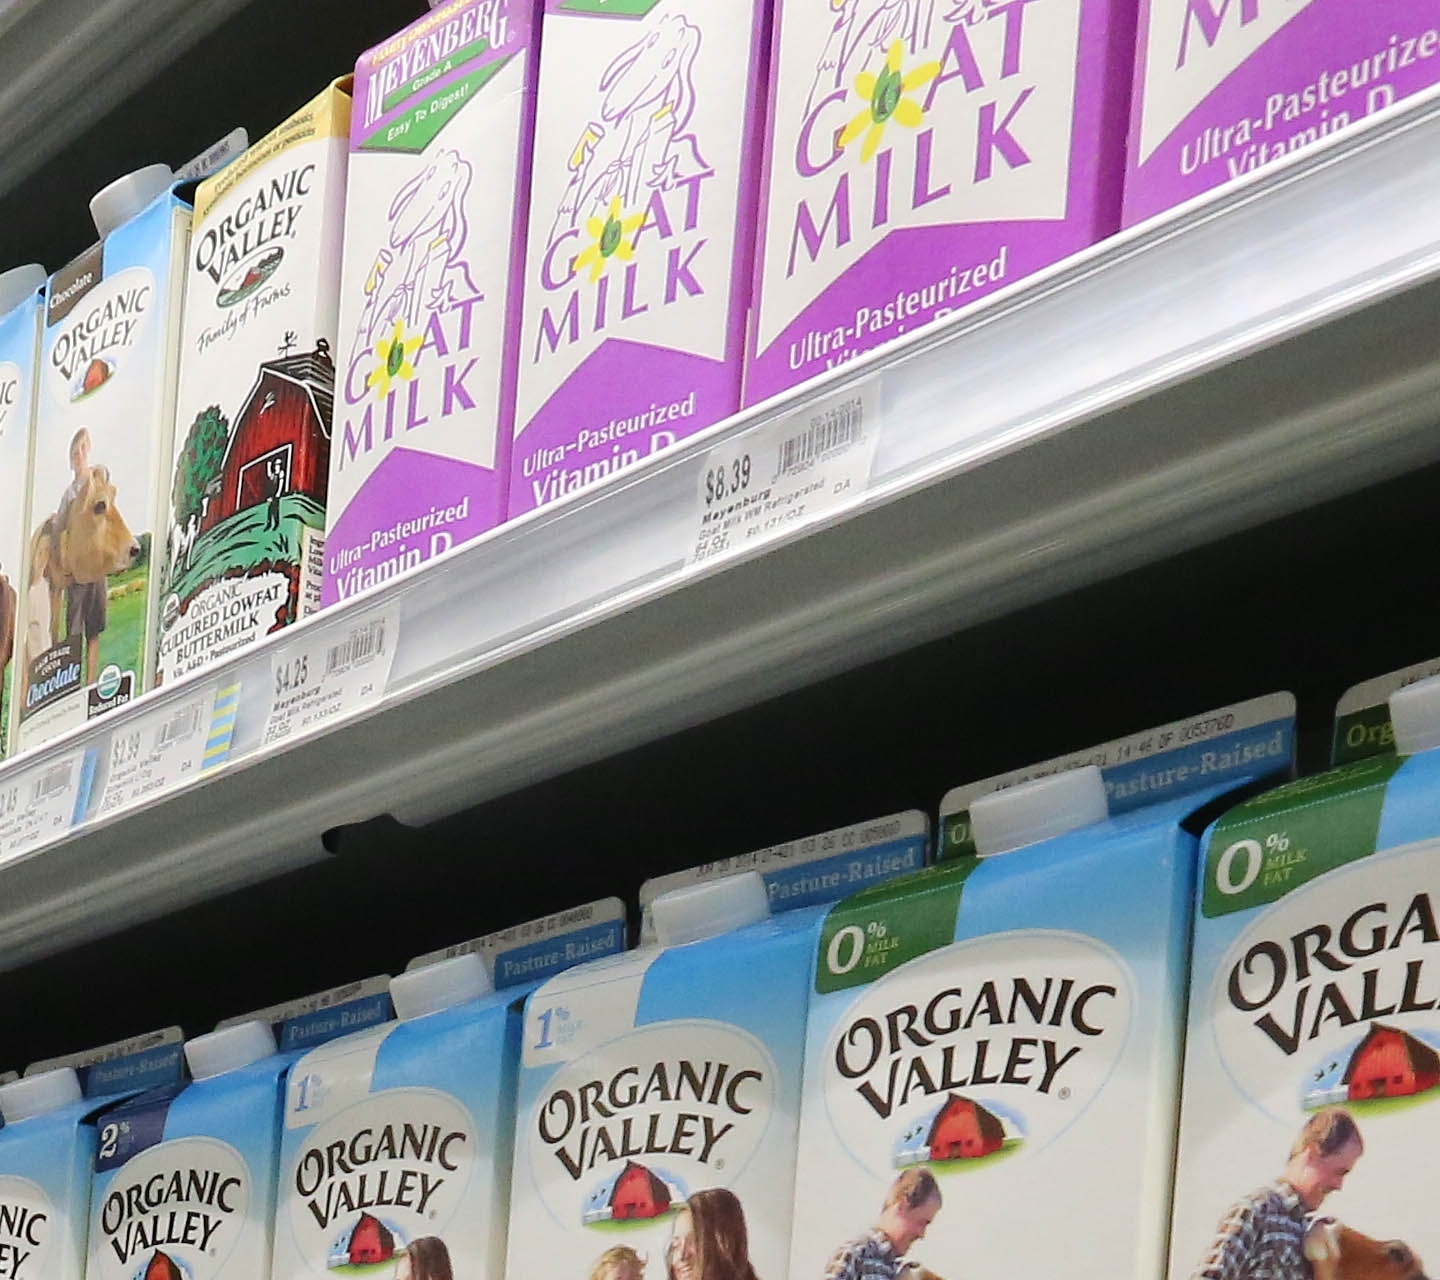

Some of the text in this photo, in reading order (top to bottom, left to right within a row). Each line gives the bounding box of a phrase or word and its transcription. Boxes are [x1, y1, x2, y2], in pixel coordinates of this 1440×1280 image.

[363, 1, 510, 128] MEYENBERG
[387, 82, 469, 142] Easy To Digest!
[196, 163, 316, 273] ORGANIC
[785, 86, 1037, 279] MILK
[207, 204, 299, 284] VALLEY
[48, 270, 93, 310] Chocolate
[197, 282, 291, 353] Family of Farms
[537, 238, 709, 362] MILK
[788, 246, 1008, 372] Ultra-Pasteurized
[50, 284, 150, 369] ORGANIC
[57, 317, 135, 383] VALLEY
[338, 357, 477, 471] MILK
[521, 394, 697, 479] Ultra-Pasteurized
[702, 488, 772, 525] Meyenburg
[706, 454, 751, 509] $8.39
[329, 497, 468, 576] Ultra-Pasteurized
[190, 581, 242, 619] ORGANIC
[336, 550, 421, 600] Vitamin
[161, 584, 282, 656] CULTURED LOWFAT
[176, 611, 260, 665] BUTTERMILK
[25, 661, 81, 708] Chocolate
[275, 655, 308, 697] $4.25
[834, 975, 1117, 1080] ORGANIC
[537, 1060, 763, 1147] ORGANIC
[856, 1038, 1082, 1121] VALLEY
[294, 1122, 468, 1198] ORGANIC
[554, 1114, 735, 1184] VALLEY
[100, 1170, 241, 1238] ORGANIC
[307, 1168, 445, 1231] VALLEY
[110, 1210, 223, 1266] VALLEY
